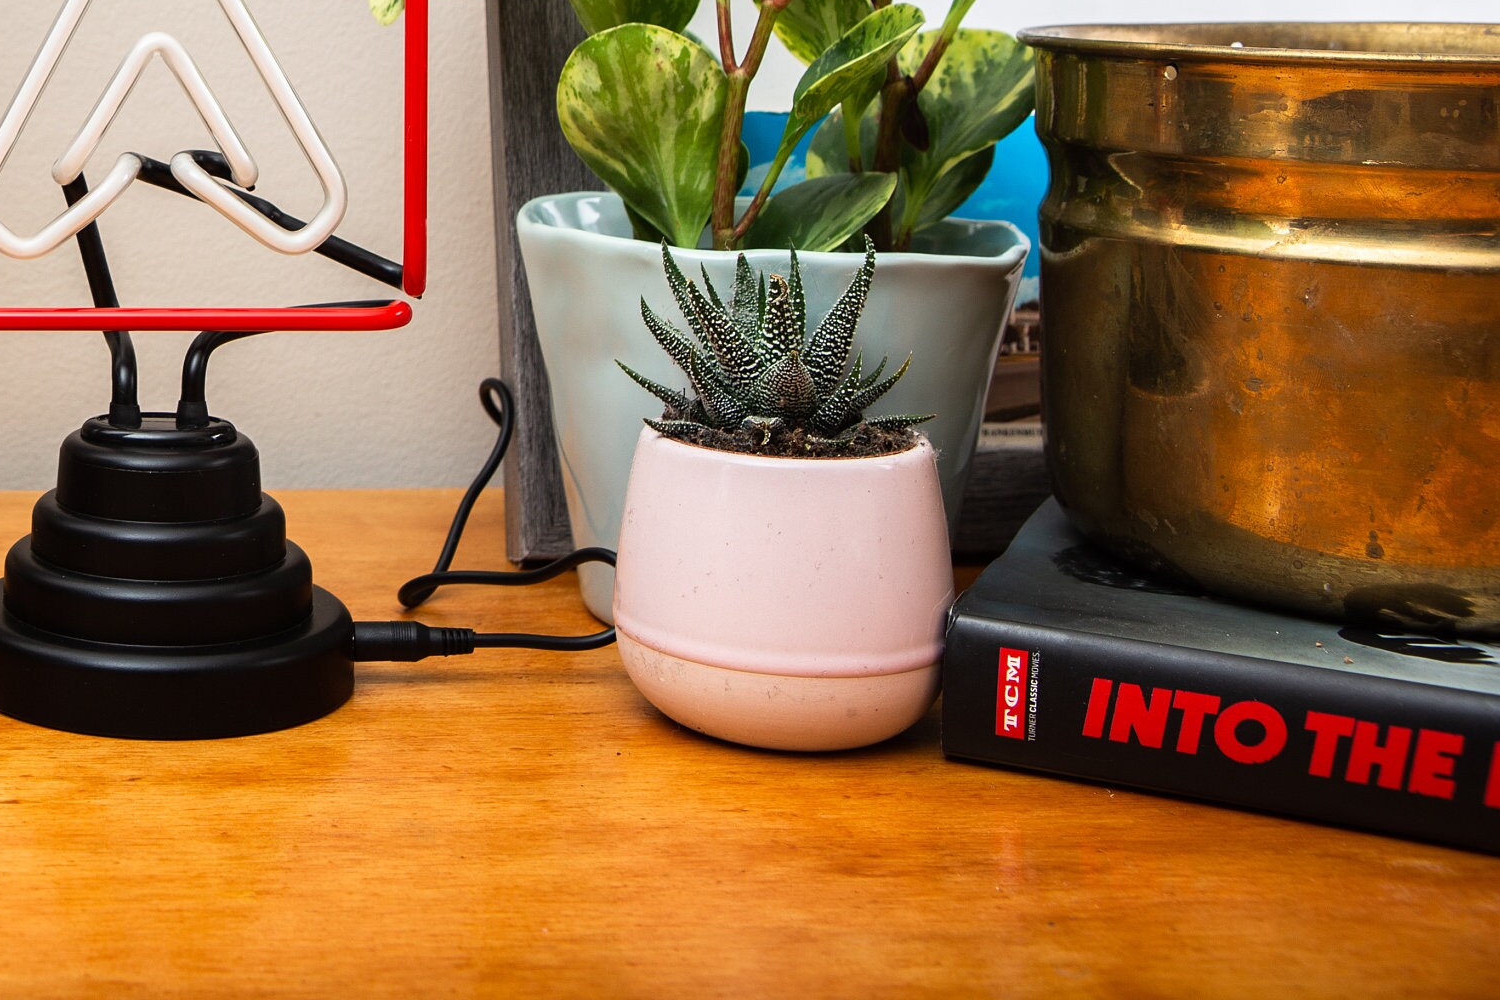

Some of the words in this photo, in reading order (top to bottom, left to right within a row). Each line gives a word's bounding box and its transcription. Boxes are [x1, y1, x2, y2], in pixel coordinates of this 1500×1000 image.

[1003, 654, 1021, 731] TCM
[1029, 680, 1039, 713] CLASSIC
[1027, 713, 1037, 741] TURNER
[1082, 677, 1288, 765] INTO
[1304, 710, 1465, 800] THE
